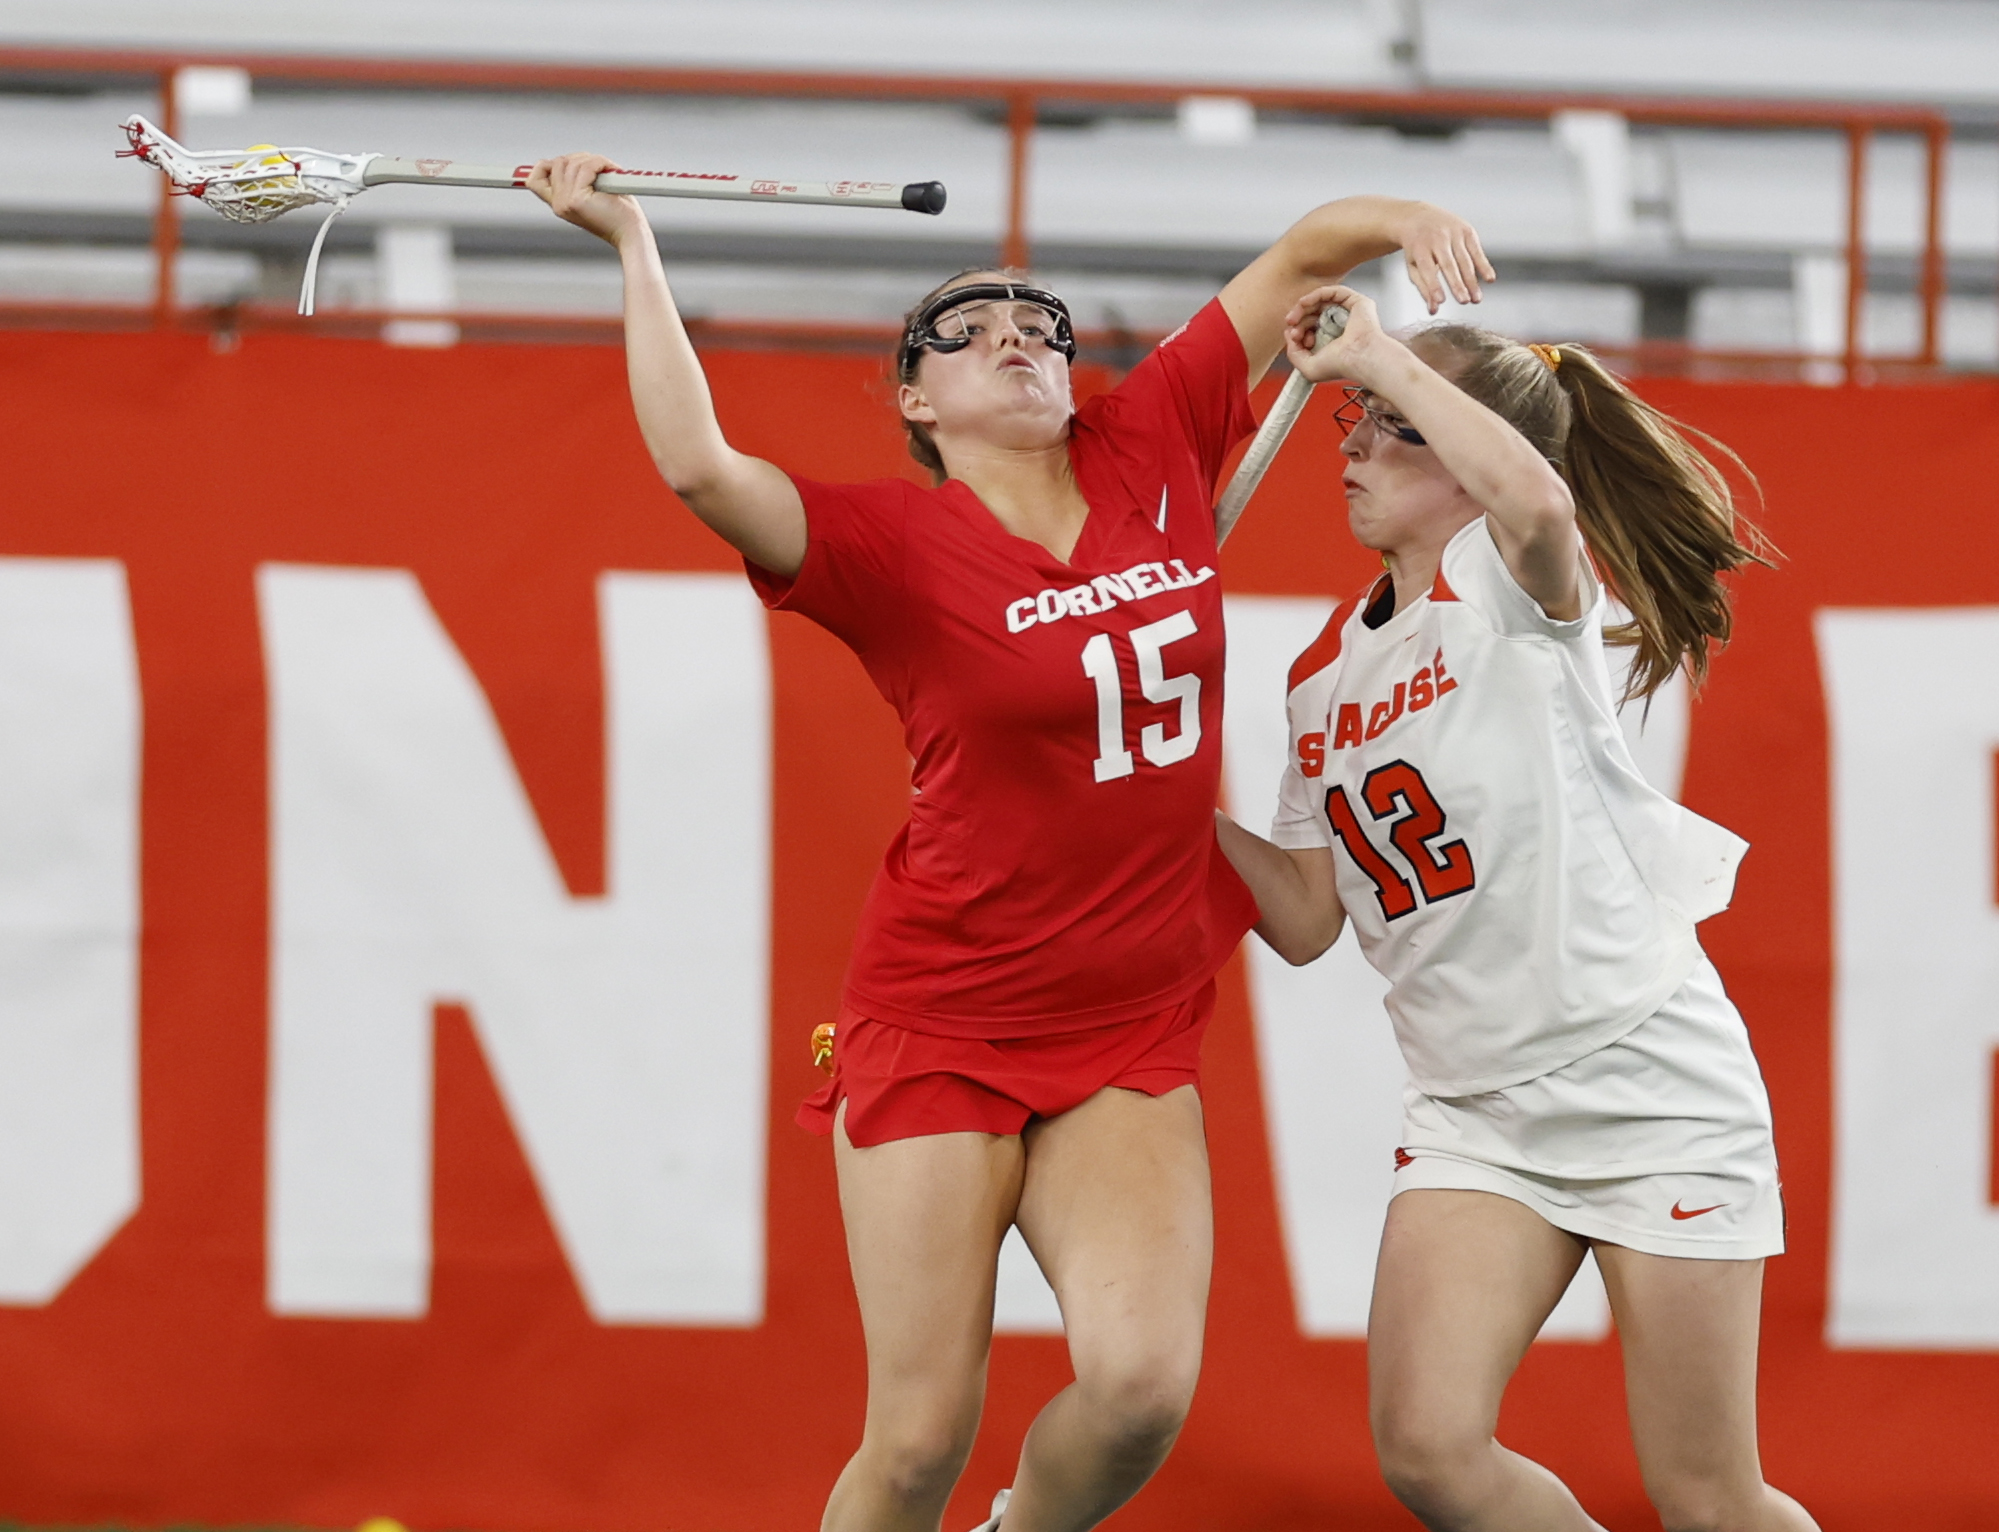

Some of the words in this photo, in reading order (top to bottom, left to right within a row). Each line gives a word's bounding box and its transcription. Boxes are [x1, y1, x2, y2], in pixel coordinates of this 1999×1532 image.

[1005, 558, 1216, 634] CORNELL
[1081, 609, 1202, 784] 15
[1297, 645, 1459, 779] SACUSE
[1324, 758, 1476, 923] 12
